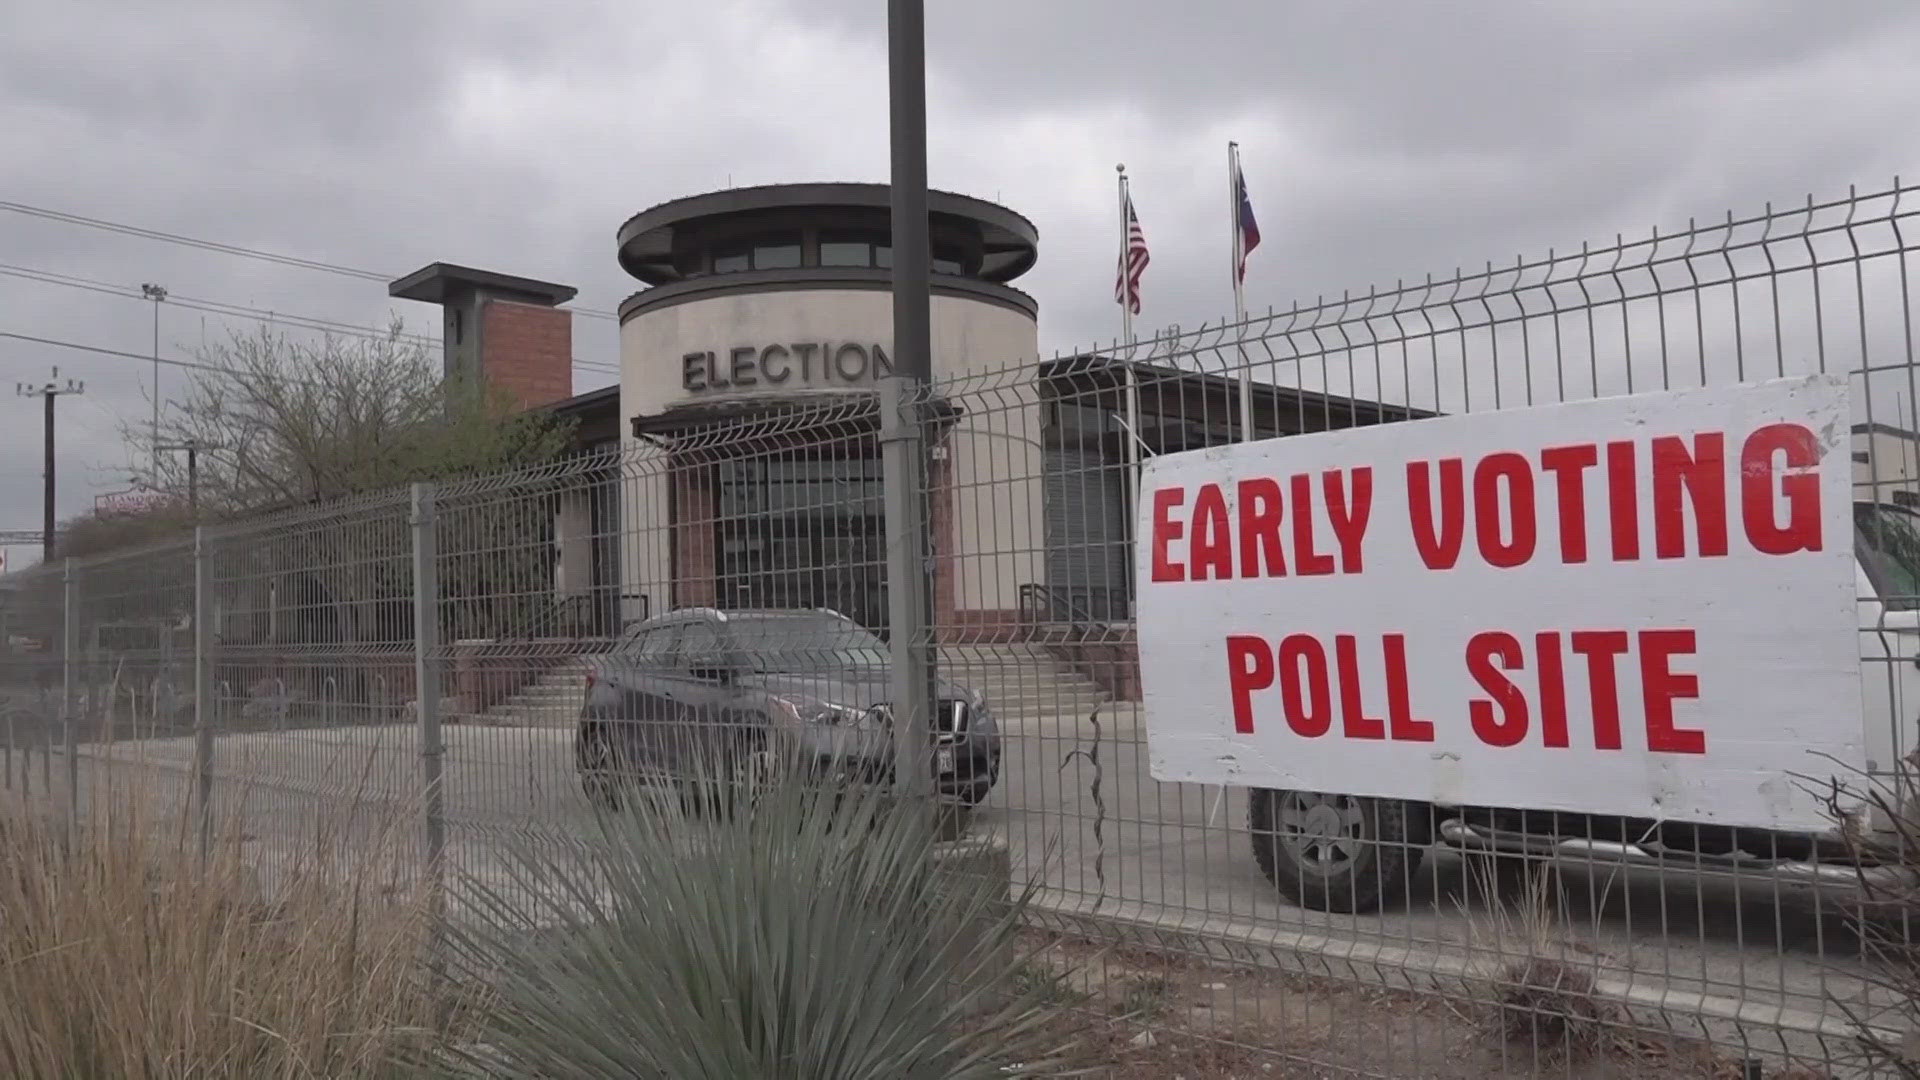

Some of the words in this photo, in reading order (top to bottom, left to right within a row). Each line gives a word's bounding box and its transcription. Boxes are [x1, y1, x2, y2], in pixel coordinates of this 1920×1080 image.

[1152, 467, 1373, 582] EARLY
[1407, 423, 1823, 570] VOTING
[1226, 633, 1435, 742] POLL
[1466, 629, 1706, 754] SITE
